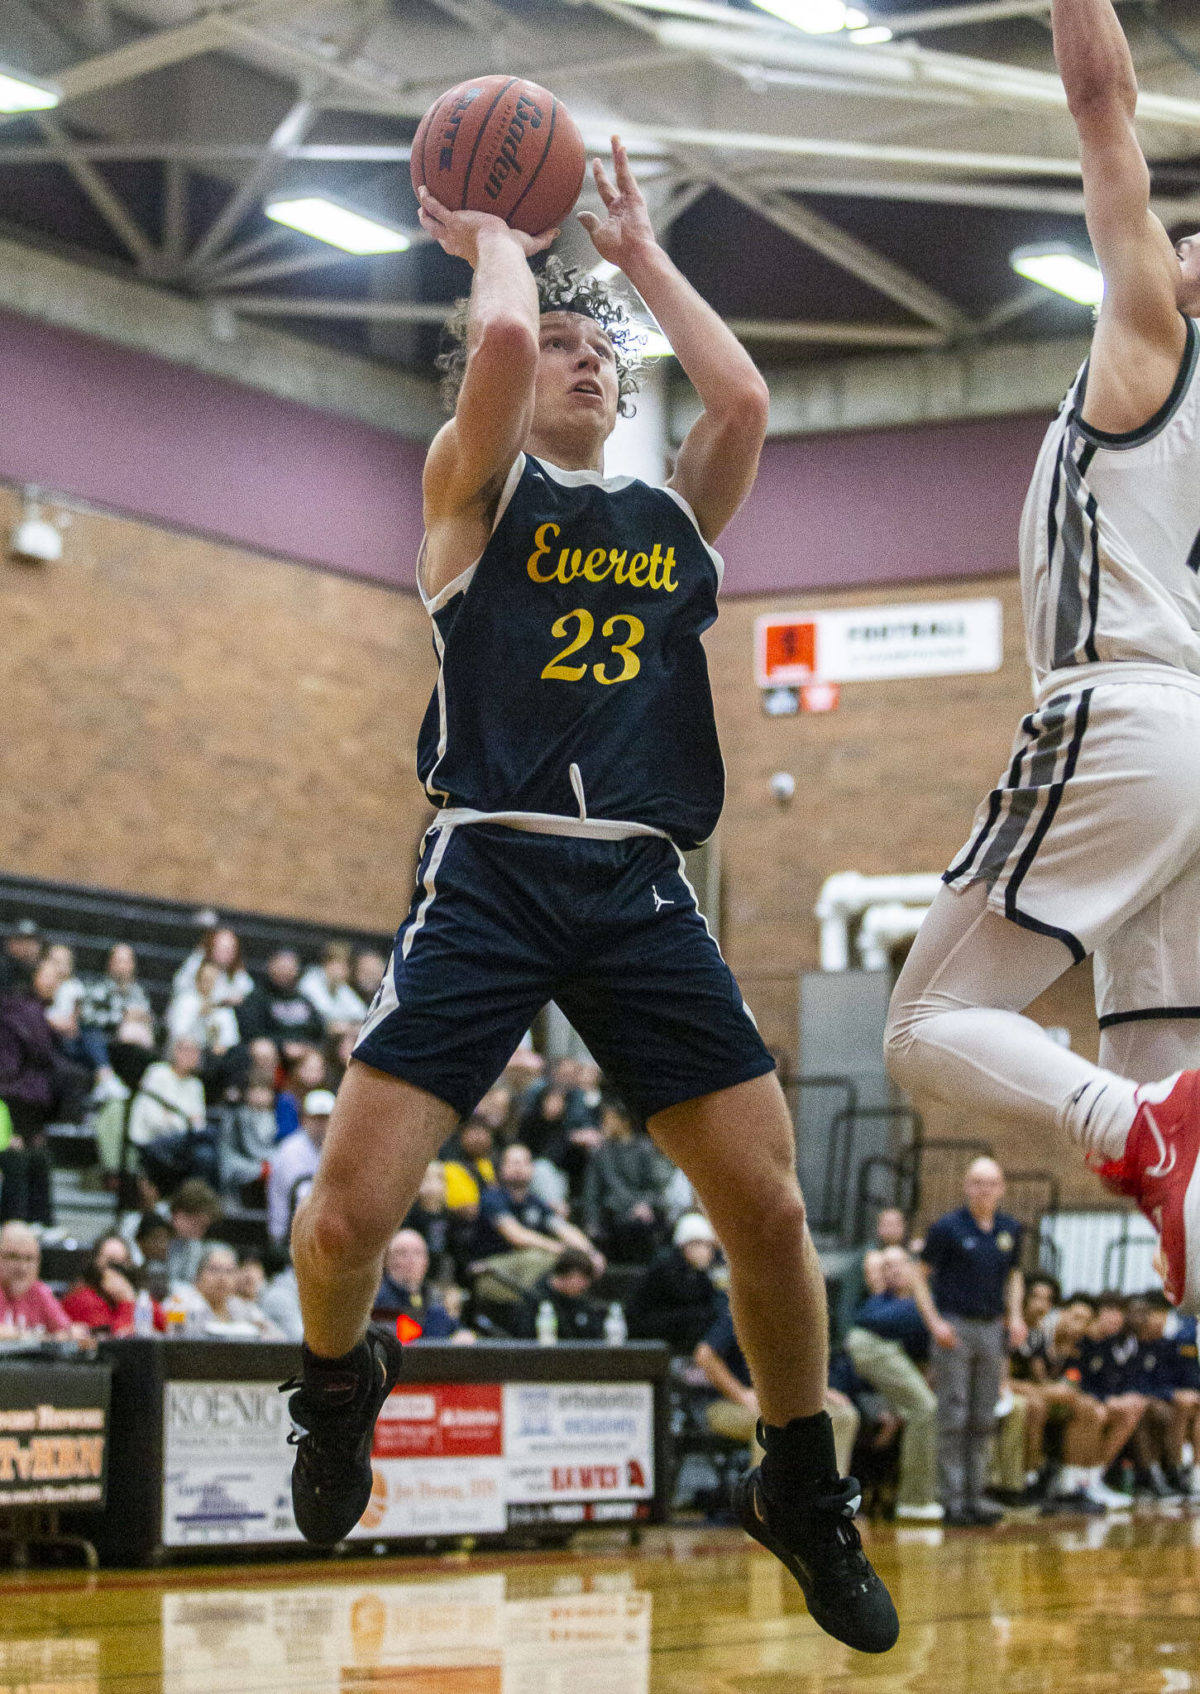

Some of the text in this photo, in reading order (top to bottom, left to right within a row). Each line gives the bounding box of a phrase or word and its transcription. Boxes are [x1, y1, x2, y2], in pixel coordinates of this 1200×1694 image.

[484, 95, 543, 199] Baden
[527, 523, 679, 592] Everett
[541, 608, 645, 685] 23
[170, 1389, 282, 1429] KOENIG
